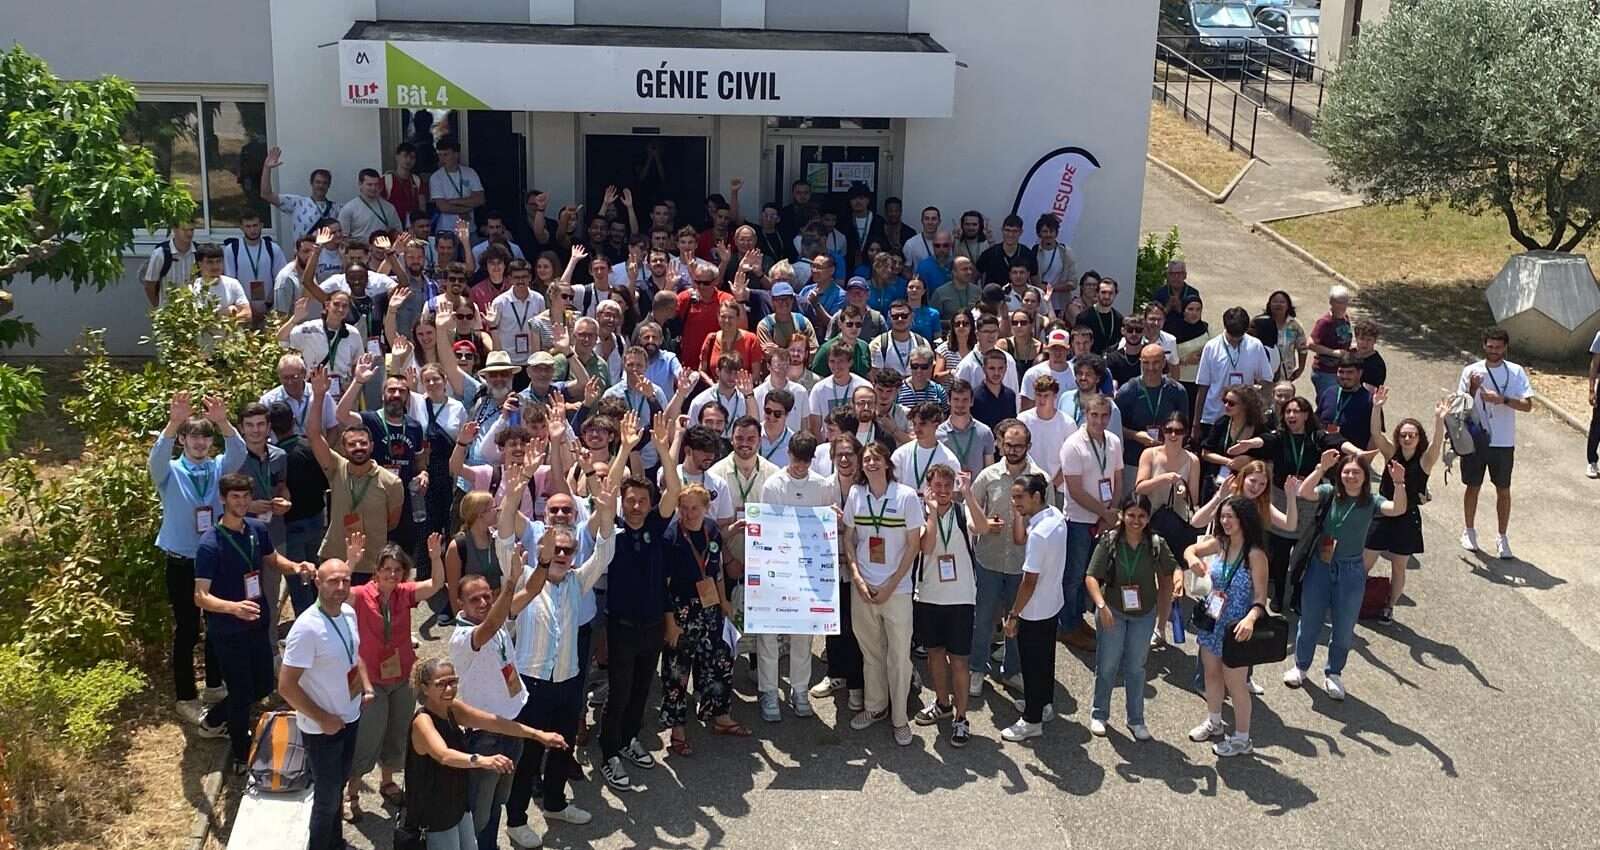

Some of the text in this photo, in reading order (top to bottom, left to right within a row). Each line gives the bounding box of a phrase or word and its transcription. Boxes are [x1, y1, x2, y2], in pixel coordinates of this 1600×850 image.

[396, 84, 449, 106] Bât. 4
[636, 61, 781, 100] GÉNIE CIVIL
